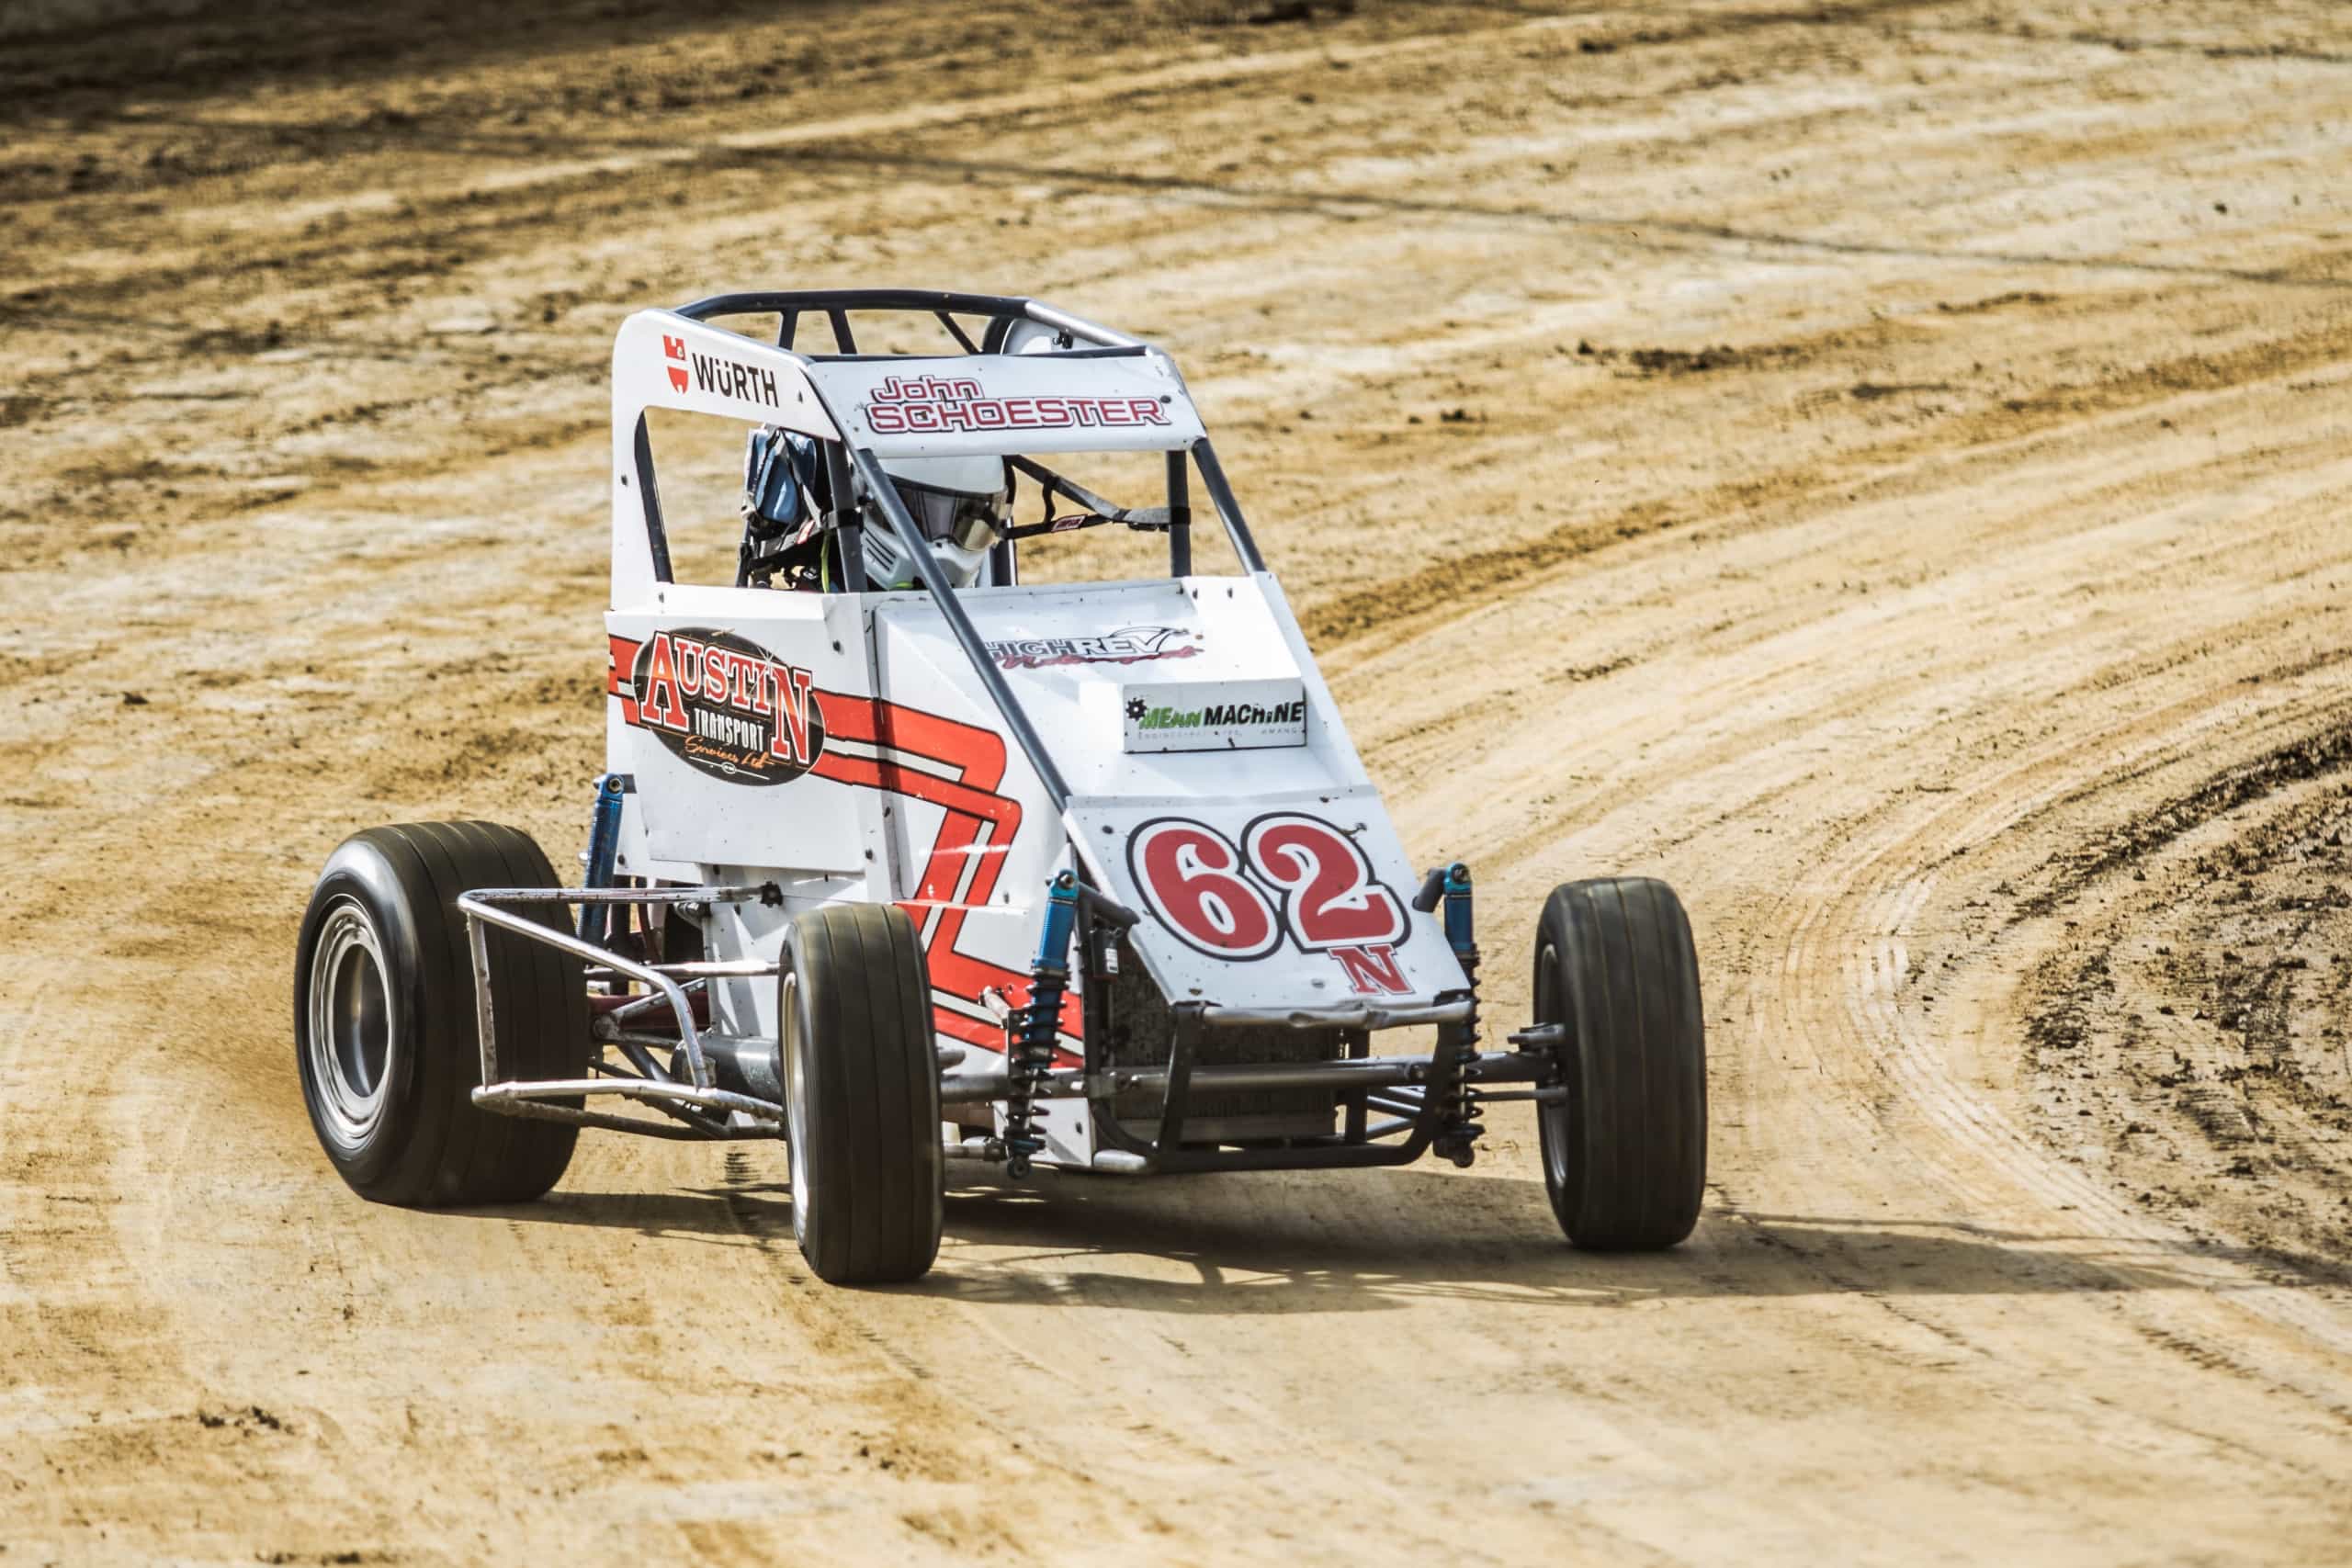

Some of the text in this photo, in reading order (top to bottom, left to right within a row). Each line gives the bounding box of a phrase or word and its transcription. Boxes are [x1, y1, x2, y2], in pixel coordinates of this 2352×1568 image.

[693, 353, 779, 407] WÜRTH
[872, 376, 984, 404] John
[865, 397, 1171, 434] SCHOESTER
[640, 631, 813, 764] AUSTIN
[694, 707, 764, 751] TRANSPORT
[1126, 812, 1411, 962] 62
[1326, 942, 1416, 996] N
